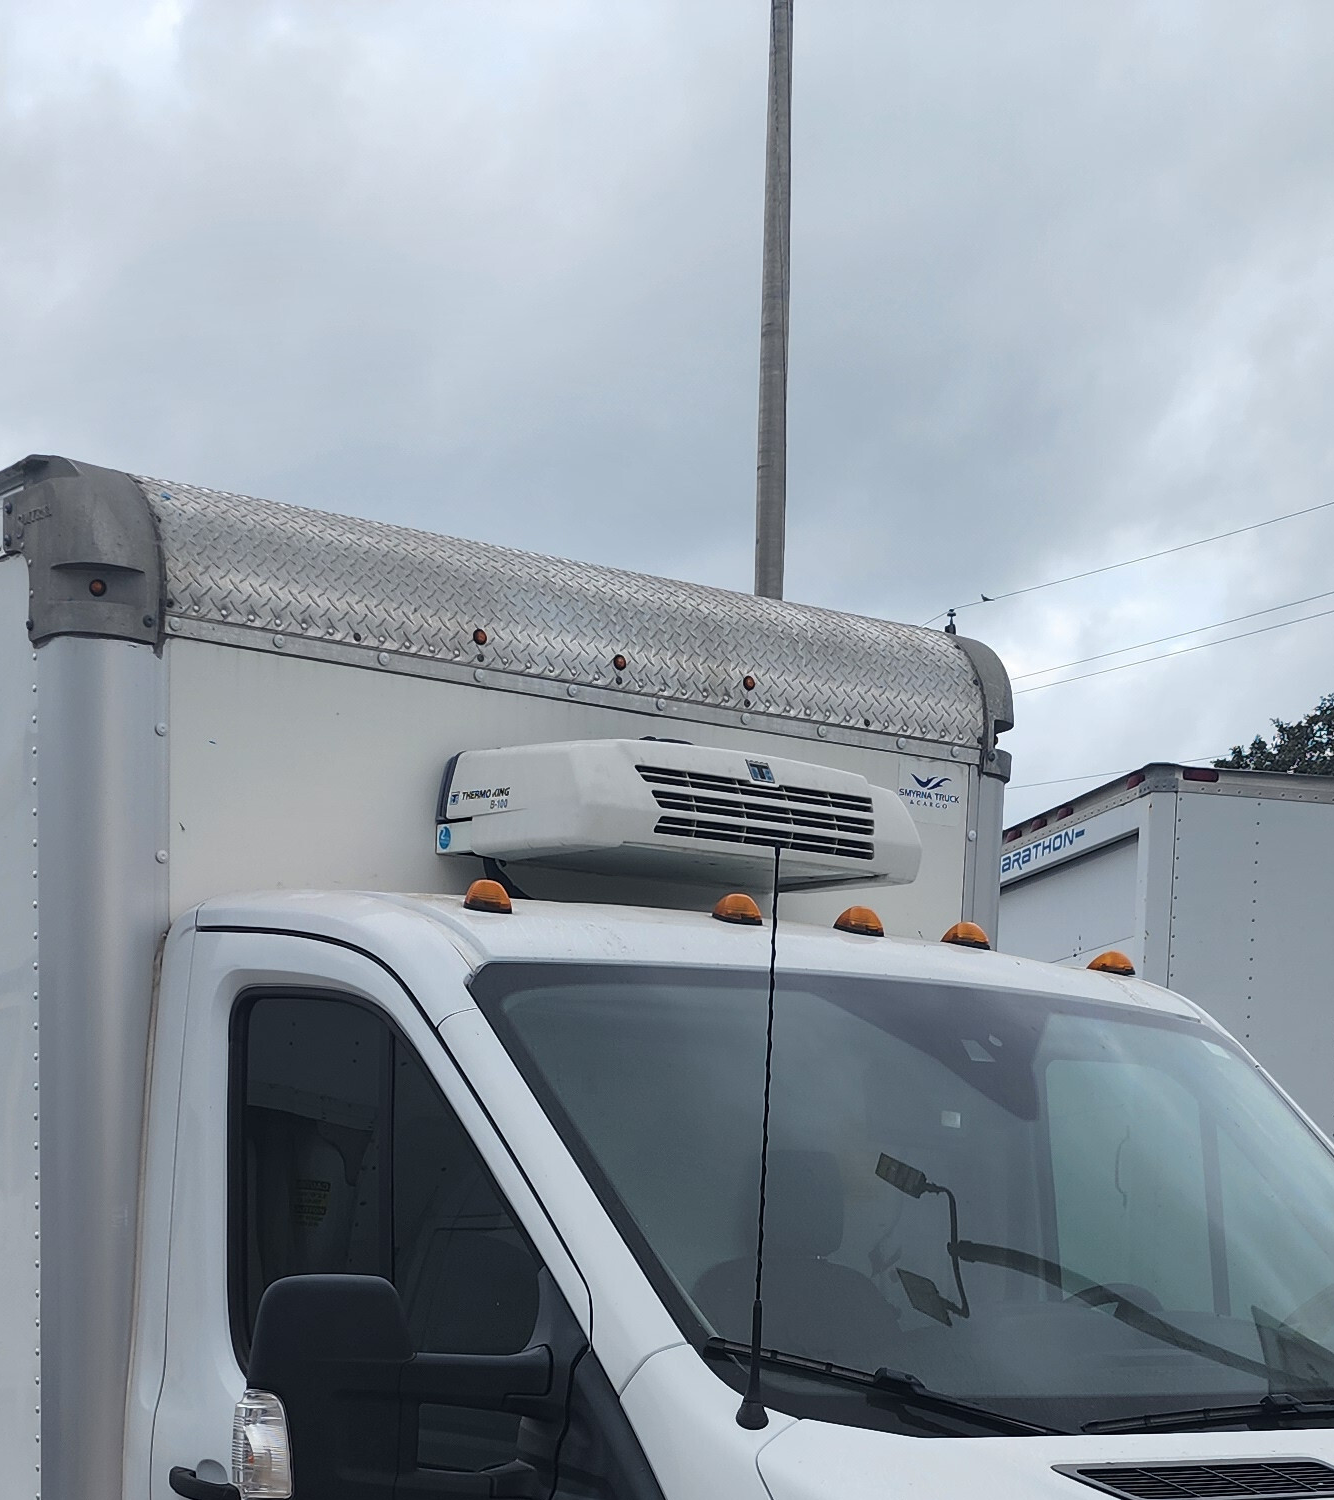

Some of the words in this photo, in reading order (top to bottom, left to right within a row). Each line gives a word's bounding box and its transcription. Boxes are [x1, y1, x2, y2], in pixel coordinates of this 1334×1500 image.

[462, 789, 491, 800] THERMO
[492, 787, 510, 797] KING
[899, 788, 932, 800] SMYRNA
[935, 792, 960, 804] TRUCK
[916, 800, 948, 809] CARGO
[1001, 829, 1075, 873] ARATHON
